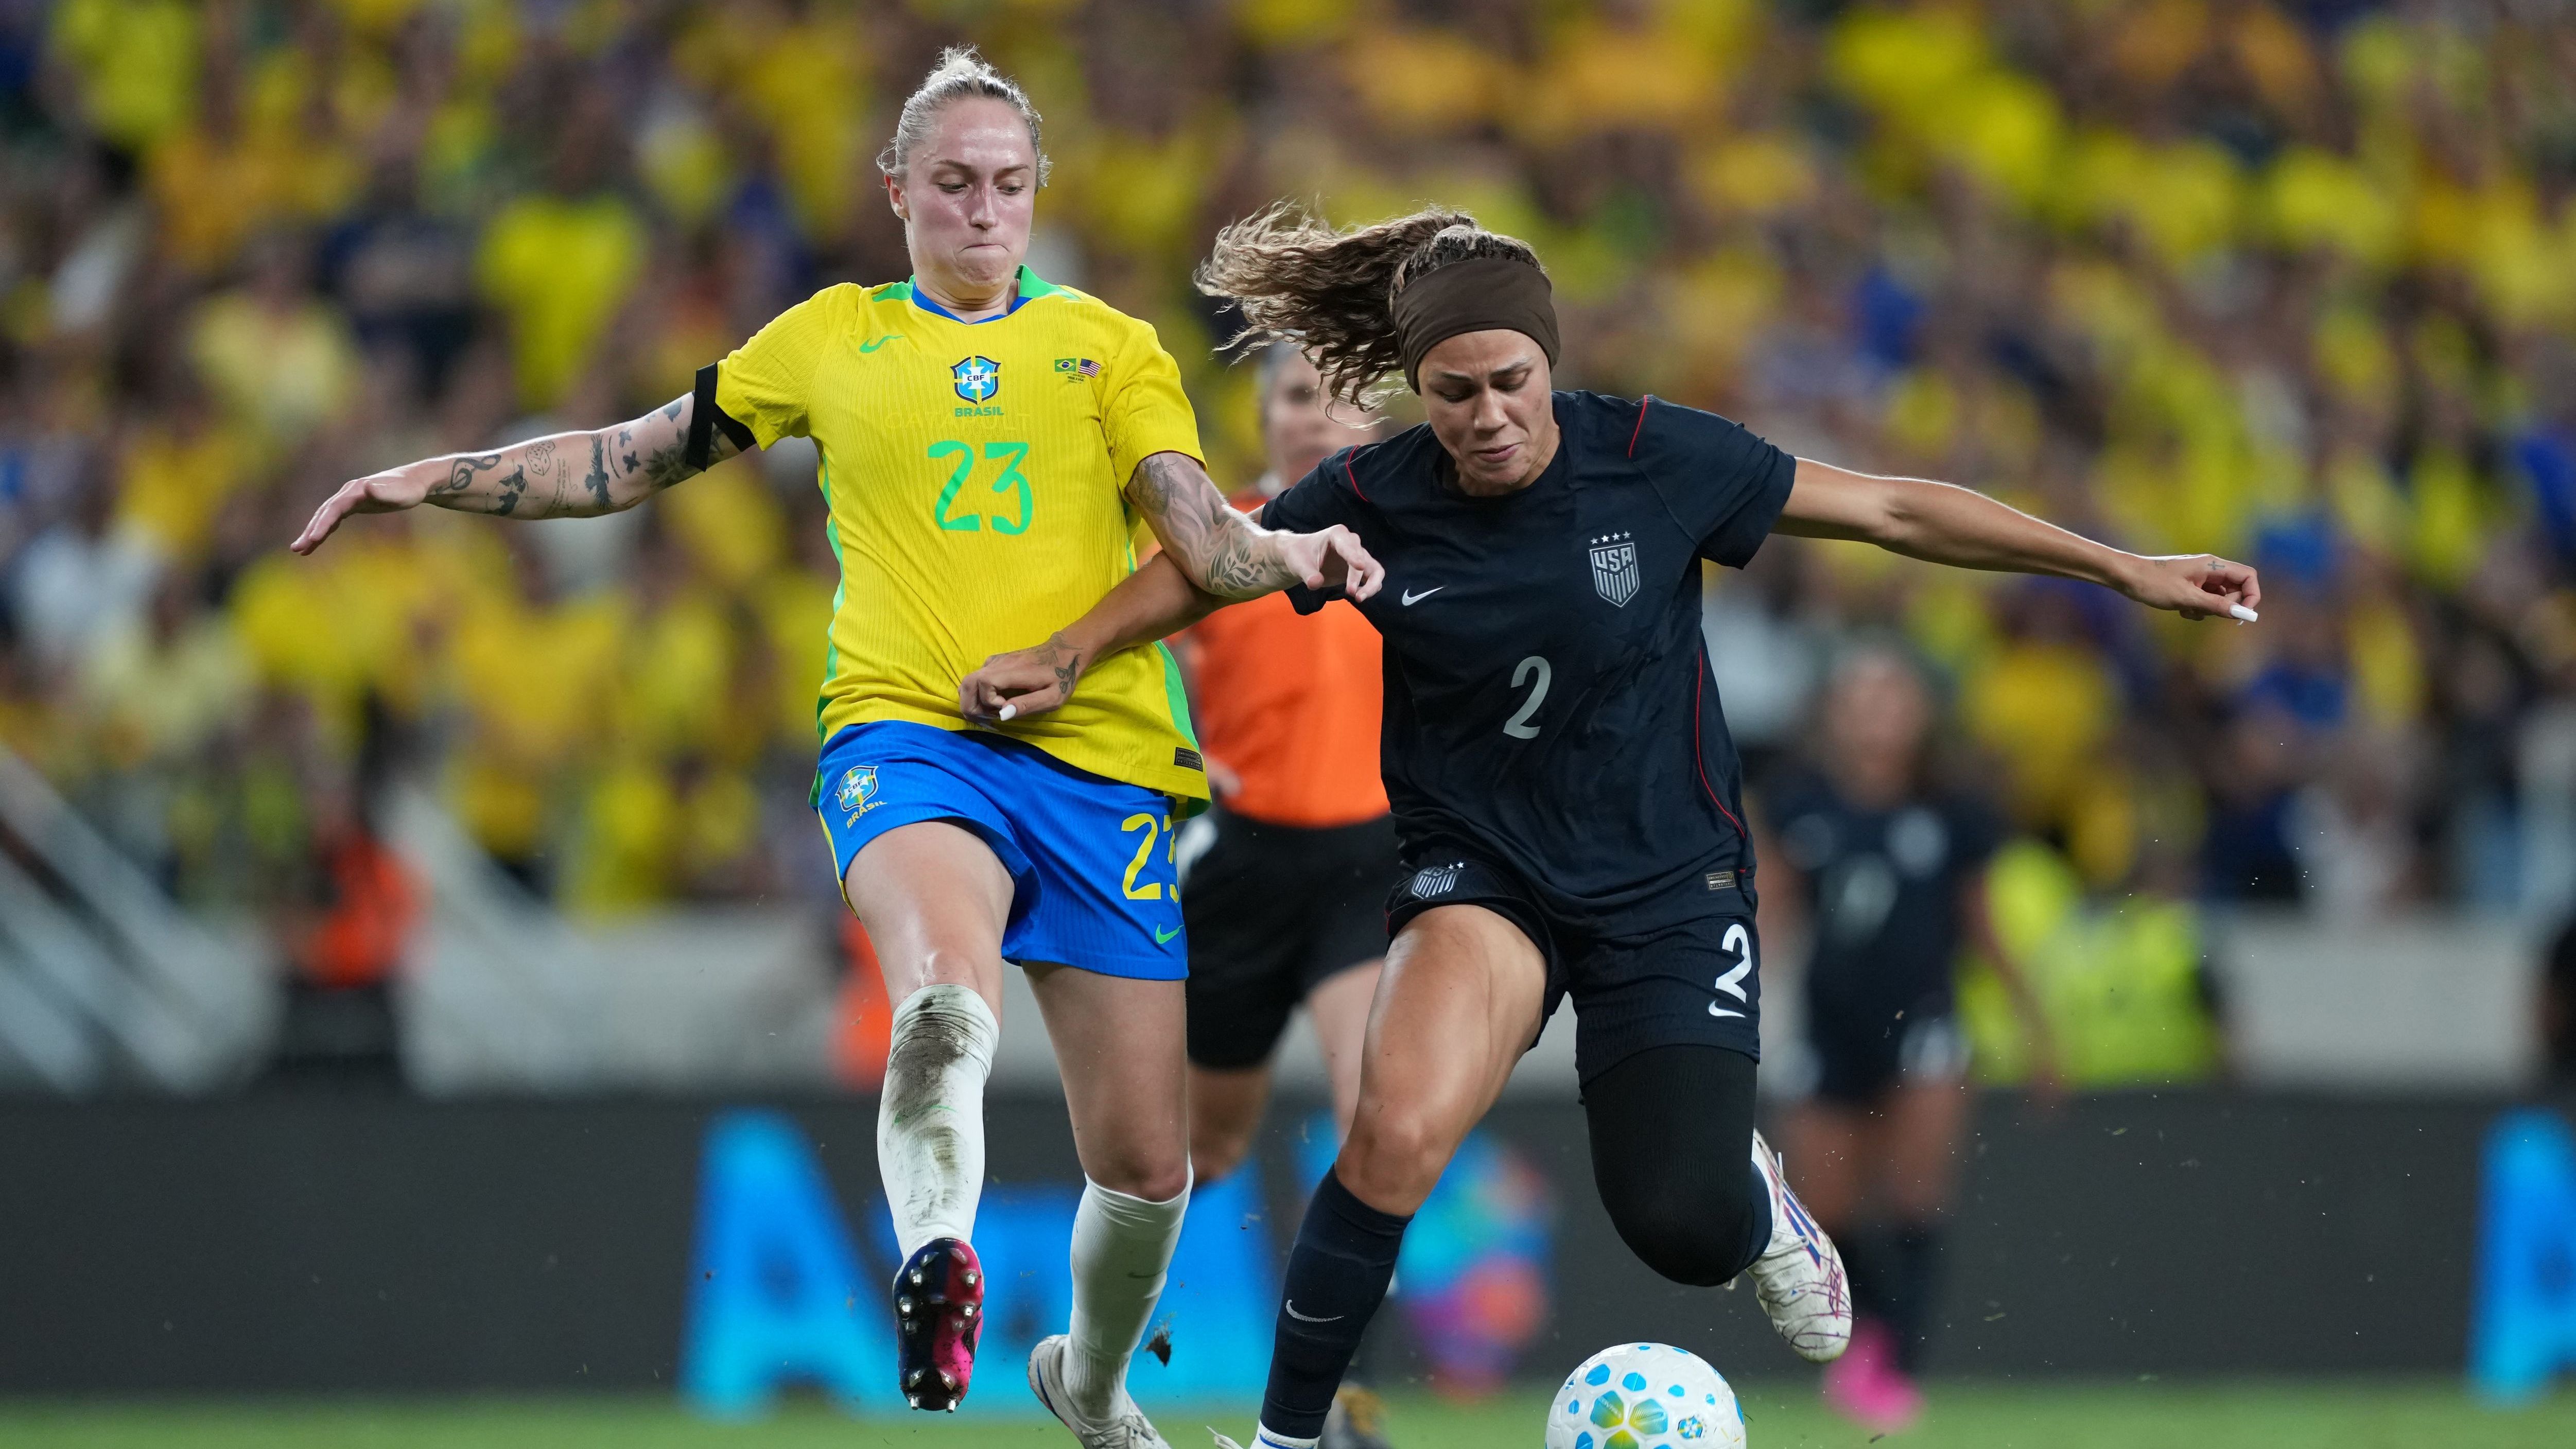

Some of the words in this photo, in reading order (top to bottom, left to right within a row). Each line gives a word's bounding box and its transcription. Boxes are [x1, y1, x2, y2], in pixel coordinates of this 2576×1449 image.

[955, 407, 1004, 417] BRASIL
[927, 440, 1033, 535] 23
[1594, 547, 1633, 572] USA
[1503, 656, 1551, 739] 2
[848, 780, 863, 793] CBF
[846, 801, 887, 829] BRASIL
[1715, 923, 1752, 1003] 2
